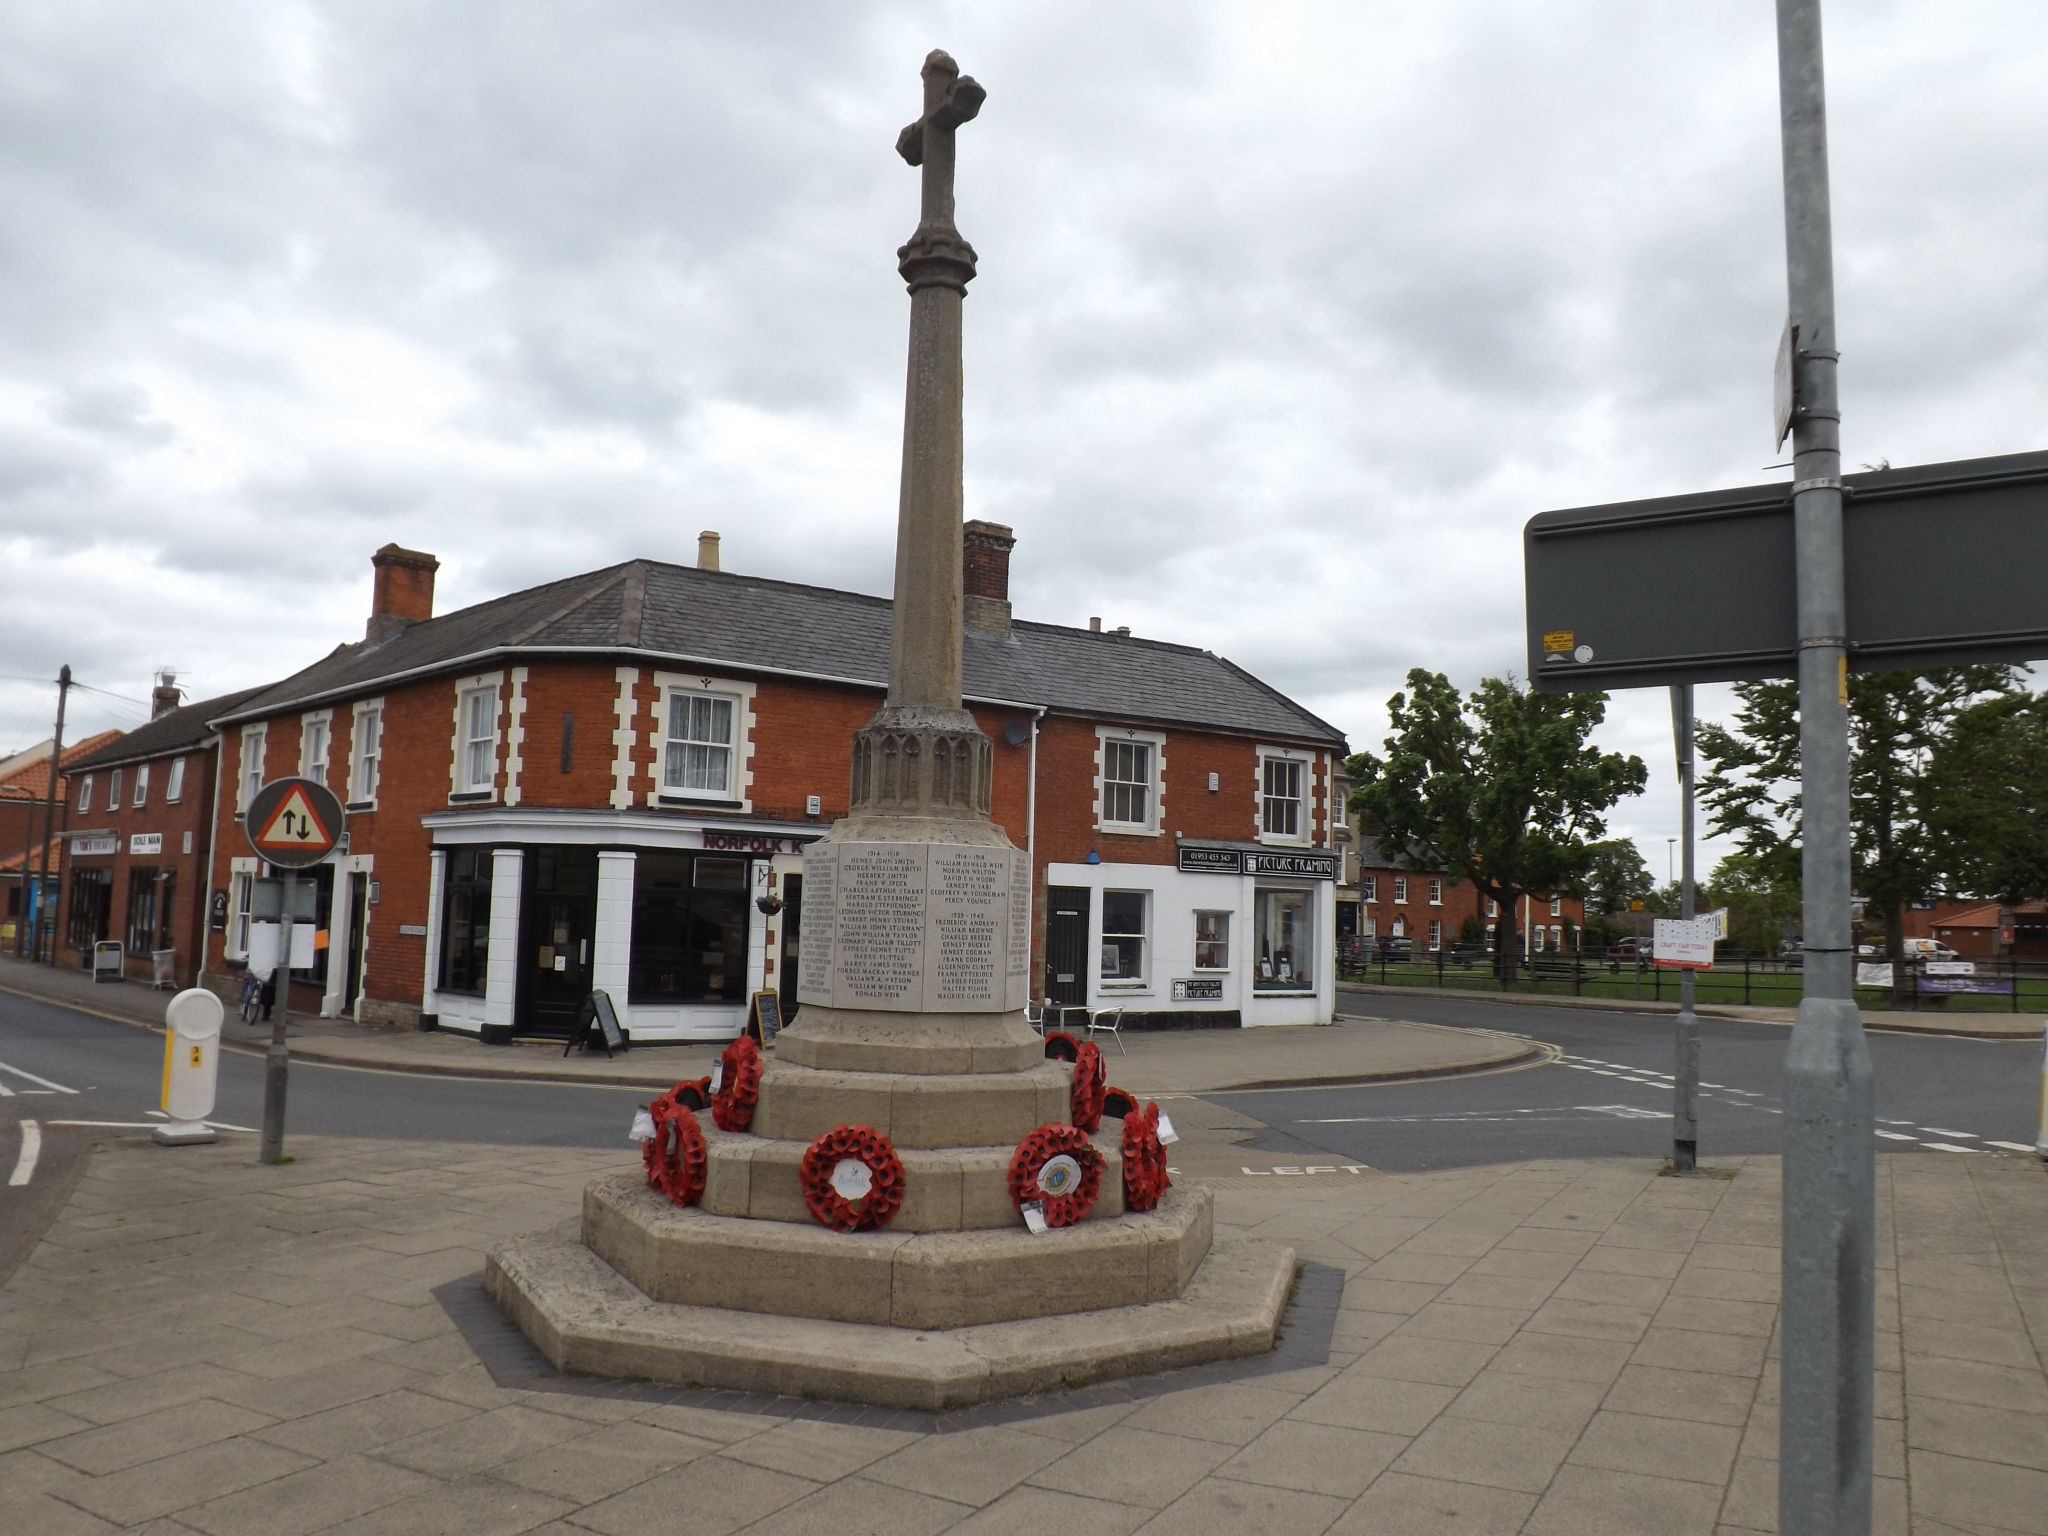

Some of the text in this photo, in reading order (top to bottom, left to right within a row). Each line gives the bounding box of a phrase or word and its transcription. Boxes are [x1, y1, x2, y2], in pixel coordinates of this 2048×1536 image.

[148, 835, 161, 845] MAN
[703, 835, 783, 852] NORFOLK
[1190, 852, 1208, 861] 01953
[1208, 853, 1220, 861] 455
[1258, 856, 1331, 873] PICTURE FRAMING
[1240, 1165, 1369, 1175] LEFT
